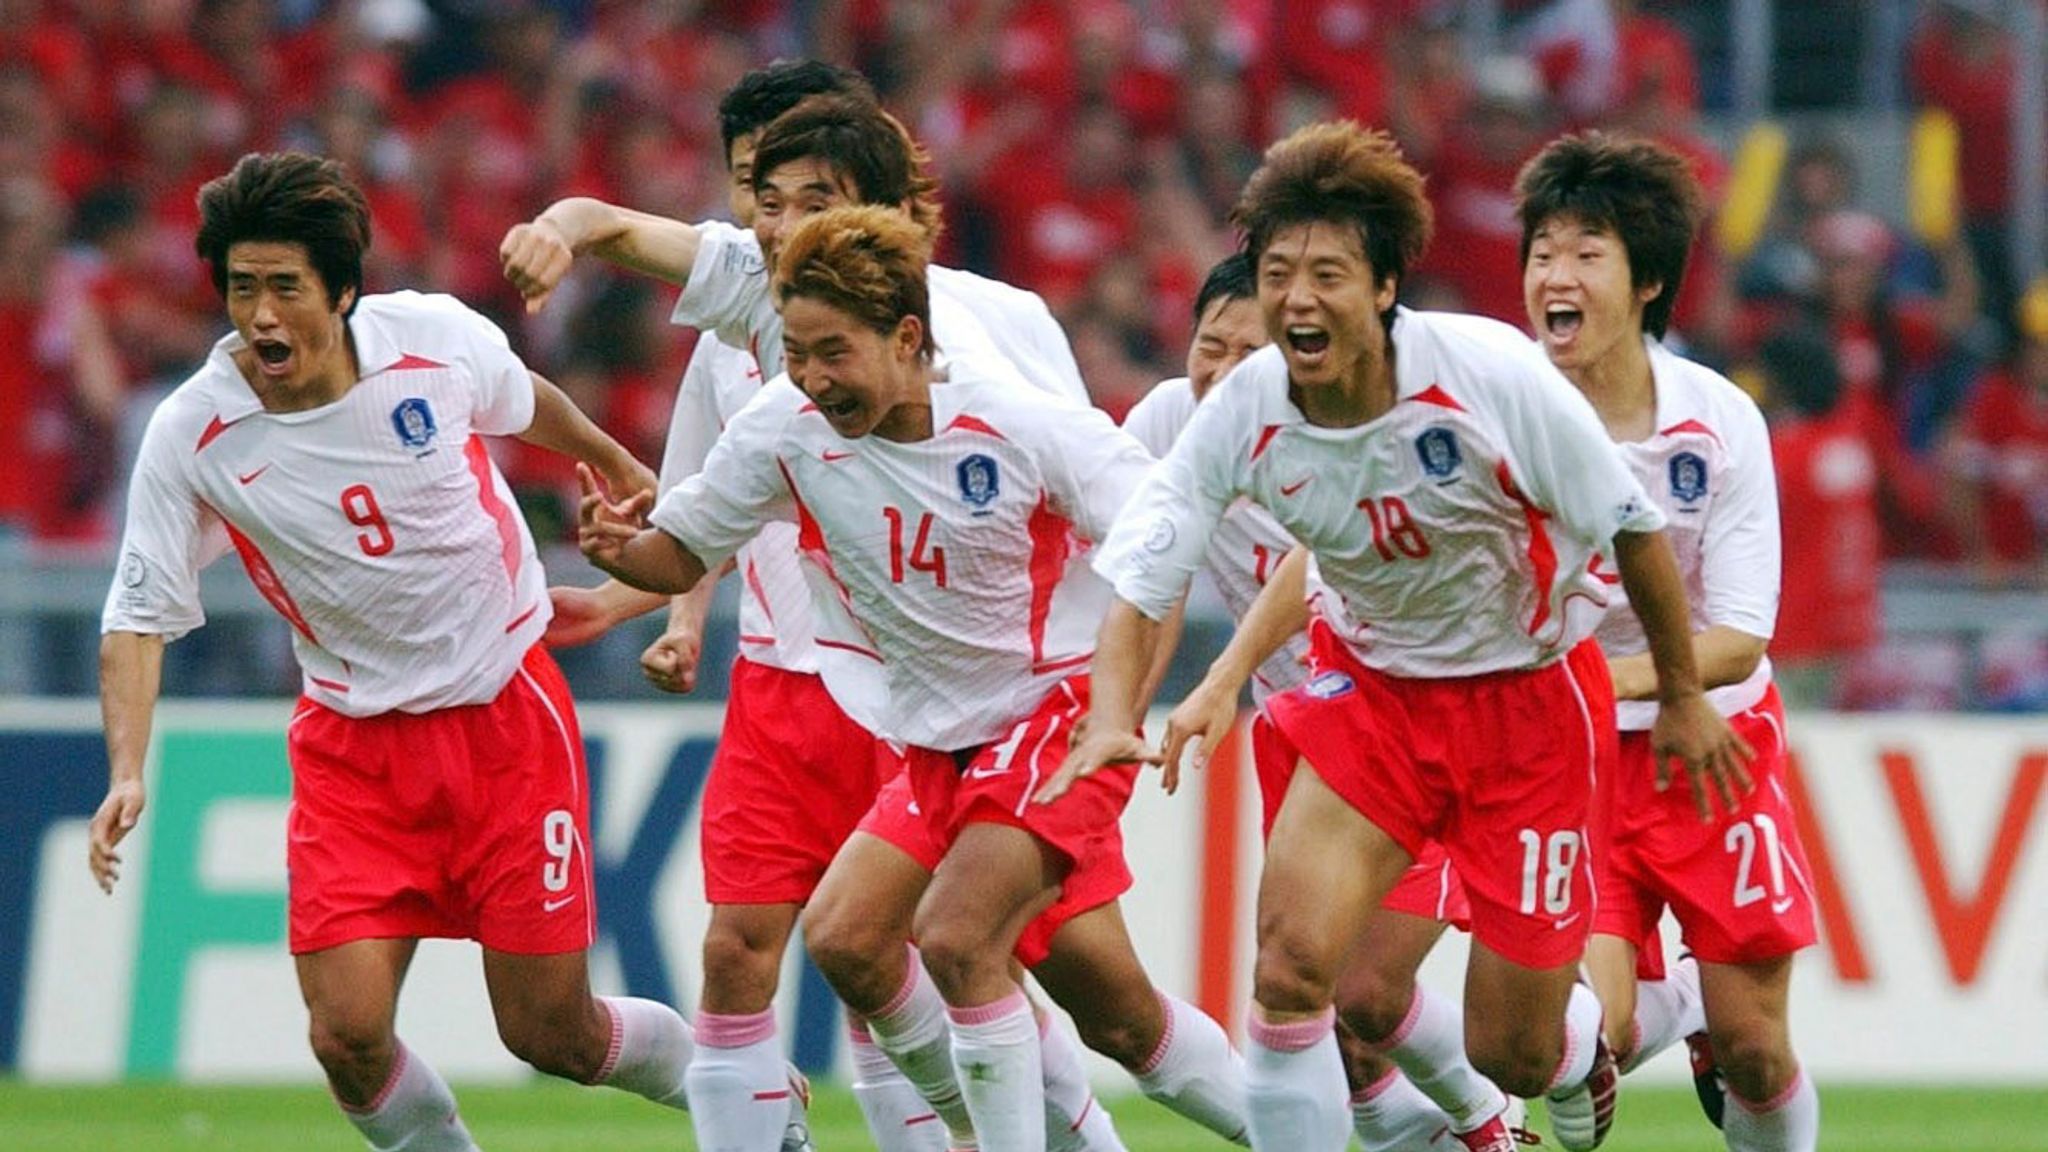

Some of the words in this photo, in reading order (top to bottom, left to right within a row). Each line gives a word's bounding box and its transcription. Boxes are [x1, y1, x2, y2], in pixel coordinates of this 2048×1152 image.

[340, 484, 395, 557] 9
[883, 506, 947, 588] 14
[1356, 496, 1431, 561] 18
[544, 810, 573, 892] 9
[1519, 829, 1580, 914] 18
[1725, 813, 1785, 907] 21
